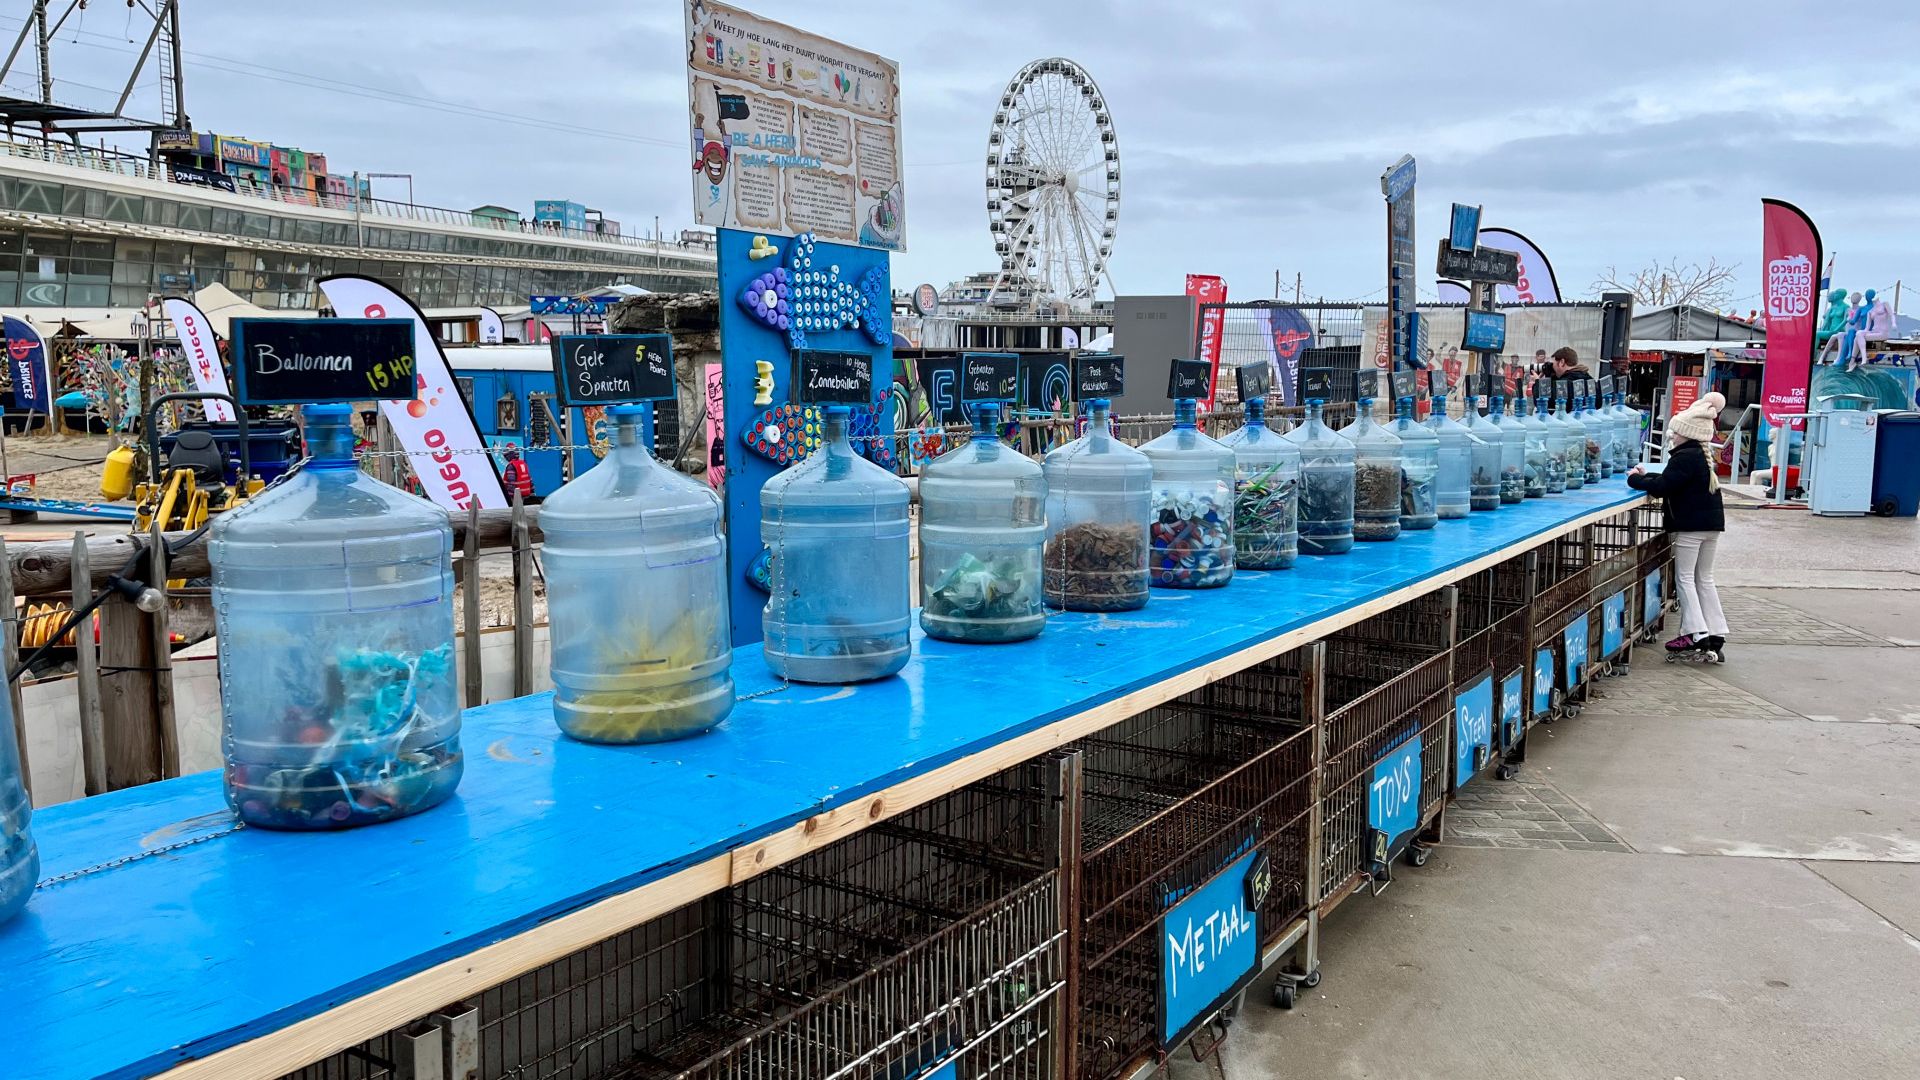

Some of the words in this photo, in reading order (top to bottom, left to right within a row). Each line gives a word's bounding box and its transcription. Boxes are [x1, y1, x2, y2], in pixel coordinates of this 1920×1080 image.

[713, 18, 736, 35] WEET
[736, 29, 745, 39] JIJ
[746, 32, 760, 42] HOE
[762, 37, 780, 49] LANG
[782, 43, 794, 52] HET
[796, 47, 815, 60] DUURT
[817, 53, 843, 68] VOORDAT
[844, 63, 857, 73] IETS
[732, 132, 749, 146] BE
[753, 132, 761, 145] A
[765, 133, 796, 150] HERO
[740, 153, 770, 168] SAVE
[774, 155, 821, 169] ANIMALS
[254, 344, 353, 375] Ballonnen
[365, 362, 389, 392] 15
[389, 355, 414, 380] HP
[574, 344, 605, 371] Gele
[635, 344, 646, 363] 5
[579, 371, 631, 397] Sprieten
[808, 368, 860, 391] Zonnebrillen
[1088, 366, 1102, 377] Post
[973, 377, 989, 394] Glas
[1459, 704, 1487, 760] STEEN
[1374, 755, 1411, 828] TOYS
[1254, 871, 1263, 901] 5
[1168, 894, 1250, 999] METAAL
